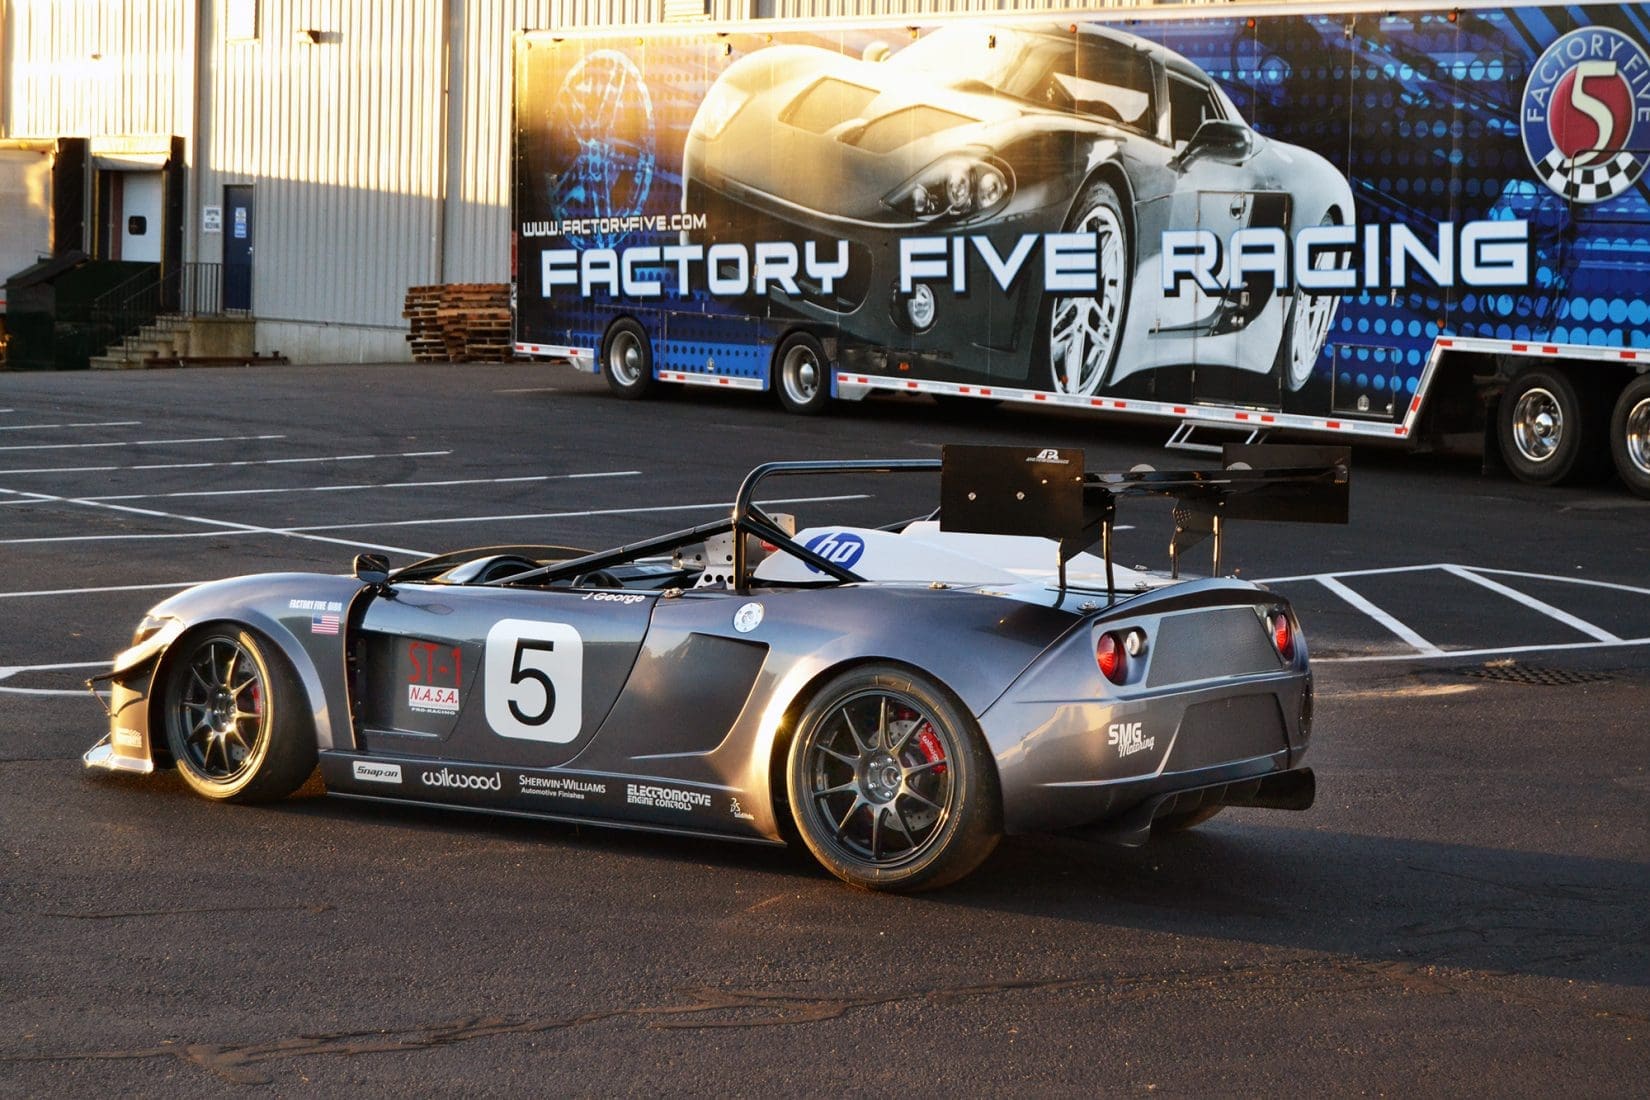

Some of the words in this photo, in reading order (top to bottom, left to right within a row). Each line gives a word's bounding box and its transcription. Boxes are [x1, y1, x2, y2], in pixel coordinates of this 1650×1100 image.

[1527, 34, 1624, 122] FACTORY
[1563, 60, 1617, 169] 5
[522, 213, 707, 238] WWW.FACTORYFIVE.COM
[541, 240, 849, 298] FACTORY
[899, 232, 1098, 293] FIVE
[1161, 220, 1529, 290] RACING
[594, 592, 646, 604] George
[507, 637, 557, 727] 5
[410, 687, 458, 704] N.A.S.A.
[1108, 722, 1142, 745] SMG
[356, 766, 398, 778] Snap-on
[422, 767, 501, 791] wilwood
[519, 774, 606, 794] SHERWIN-WILLIAMS
[521, 787, 557, 798] Automotive
[558, 791, 585, 800] Finishes
[627, 783, 712, 807] ELECTROMOTIVE
[627, 795, 654, 806] ENGINE
[655, 798, 692, 811] CONTROLS
